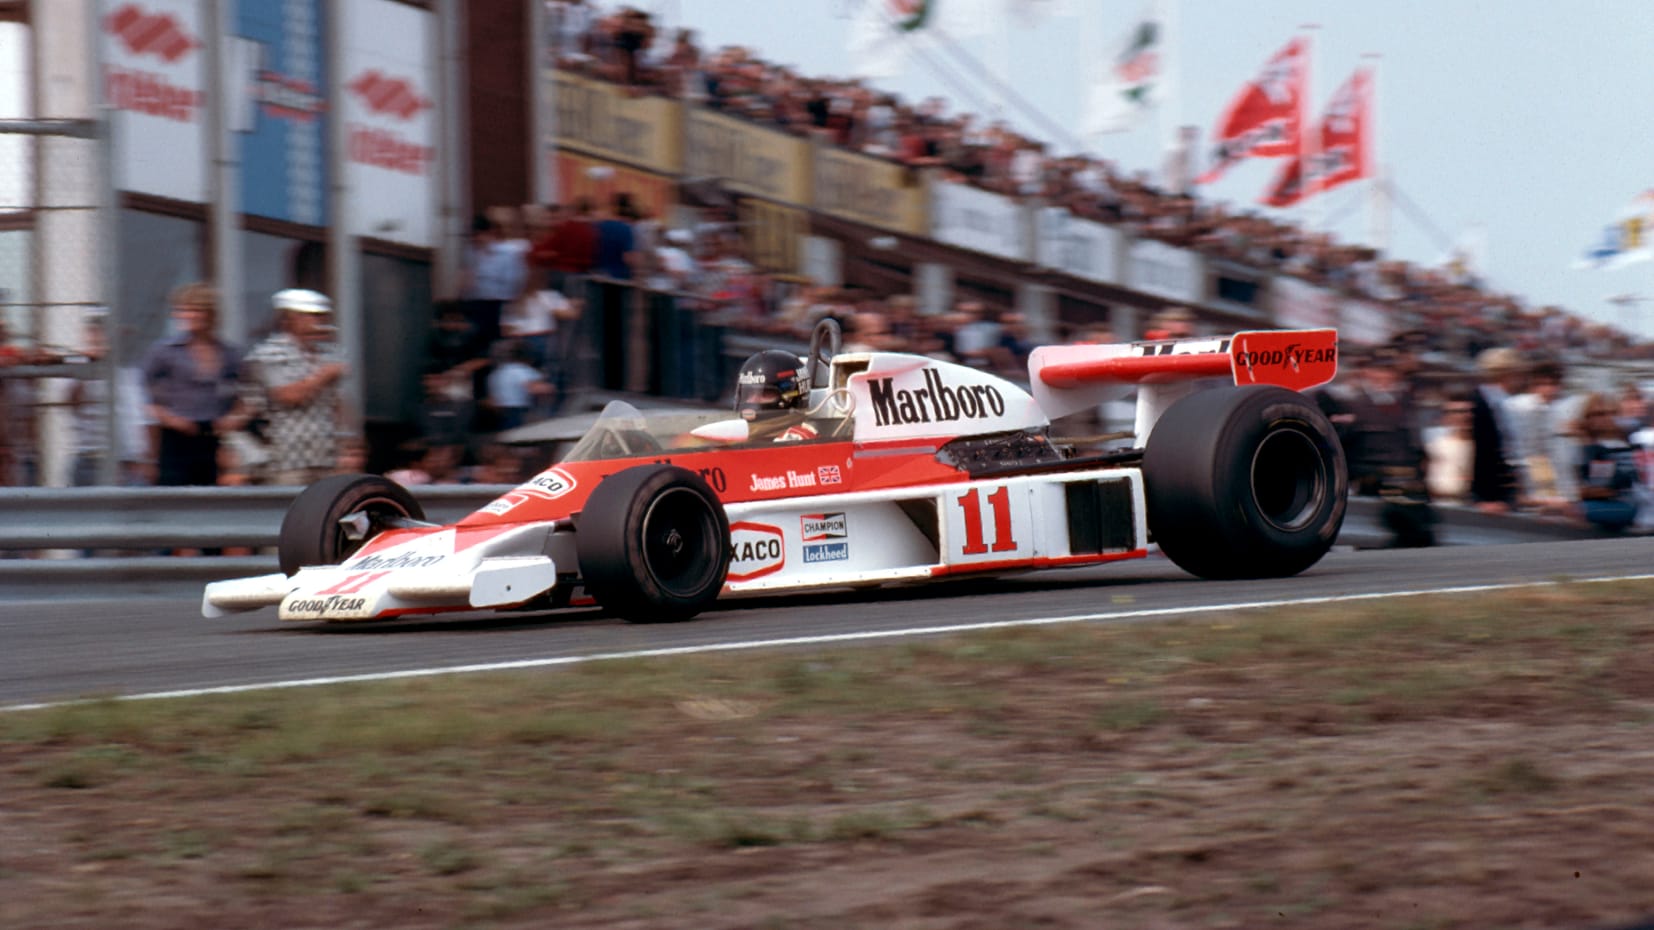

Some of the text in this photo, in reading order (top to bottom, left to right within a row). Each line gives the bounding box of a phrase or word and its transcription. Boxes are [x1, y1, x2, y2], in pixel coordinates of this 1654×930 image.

[870, 367, 1005, 427] Marlboro
[750, 471, 817, 492] James Hunt
[804, 521, 844, 533] CHAMPION
[957, 486, 1018, 556] 11
[349, 551, 445, 571] Marlboro
[805, 546, 847, 561] Lockheed
